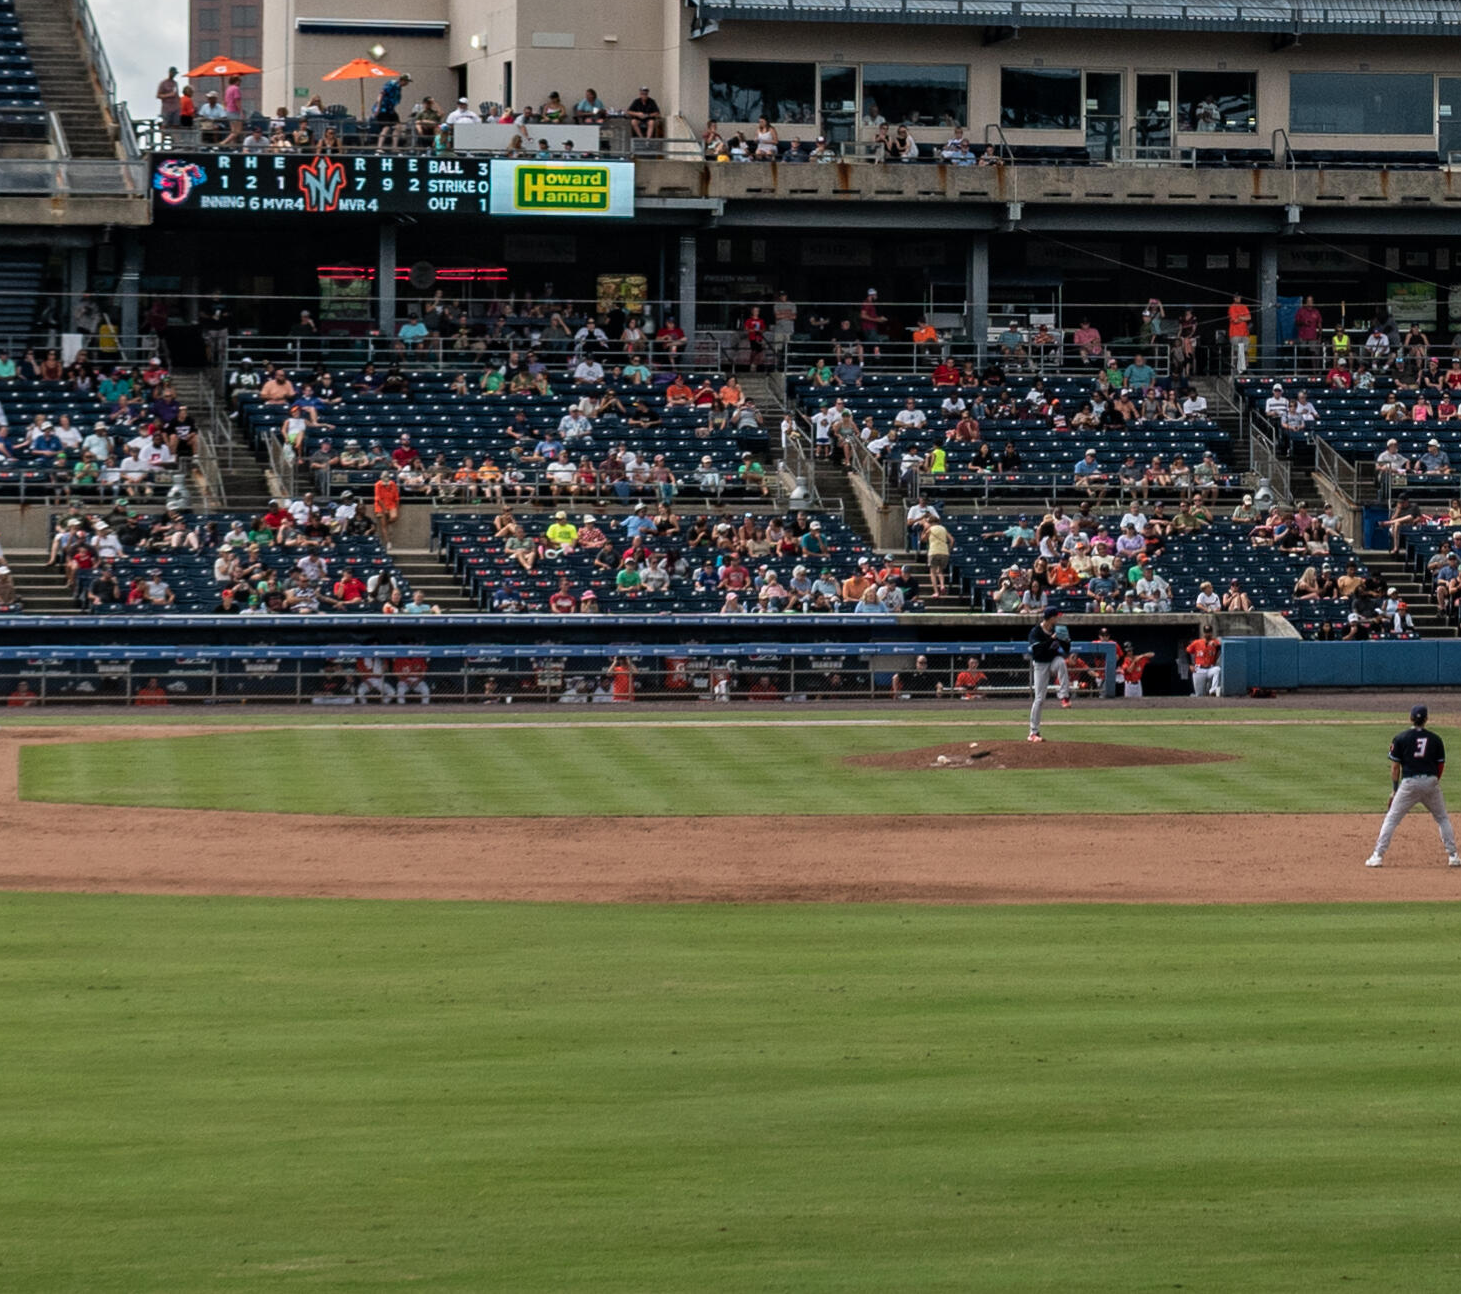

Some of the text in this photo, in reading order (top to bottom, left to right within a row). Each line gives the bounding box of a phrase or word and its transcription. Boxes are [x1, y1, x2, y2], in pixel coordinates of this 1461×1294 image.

[218, 156, 286, 169] R H E
[354, 158, 418, 172] R H E
[428, 161, 488, 176] BALL 3
[220, 175, 285, 189] 1 2 1
[355, 177, 420, 191] 7 9 2
[428, 180, 489, 193] STRIKE 0
[201, 195, 245, 209] INNING
[249, 196, 260, 210] 6
[428, 197, 487, 212] OUT 1
[1413, 737, 1428, 758] 3
